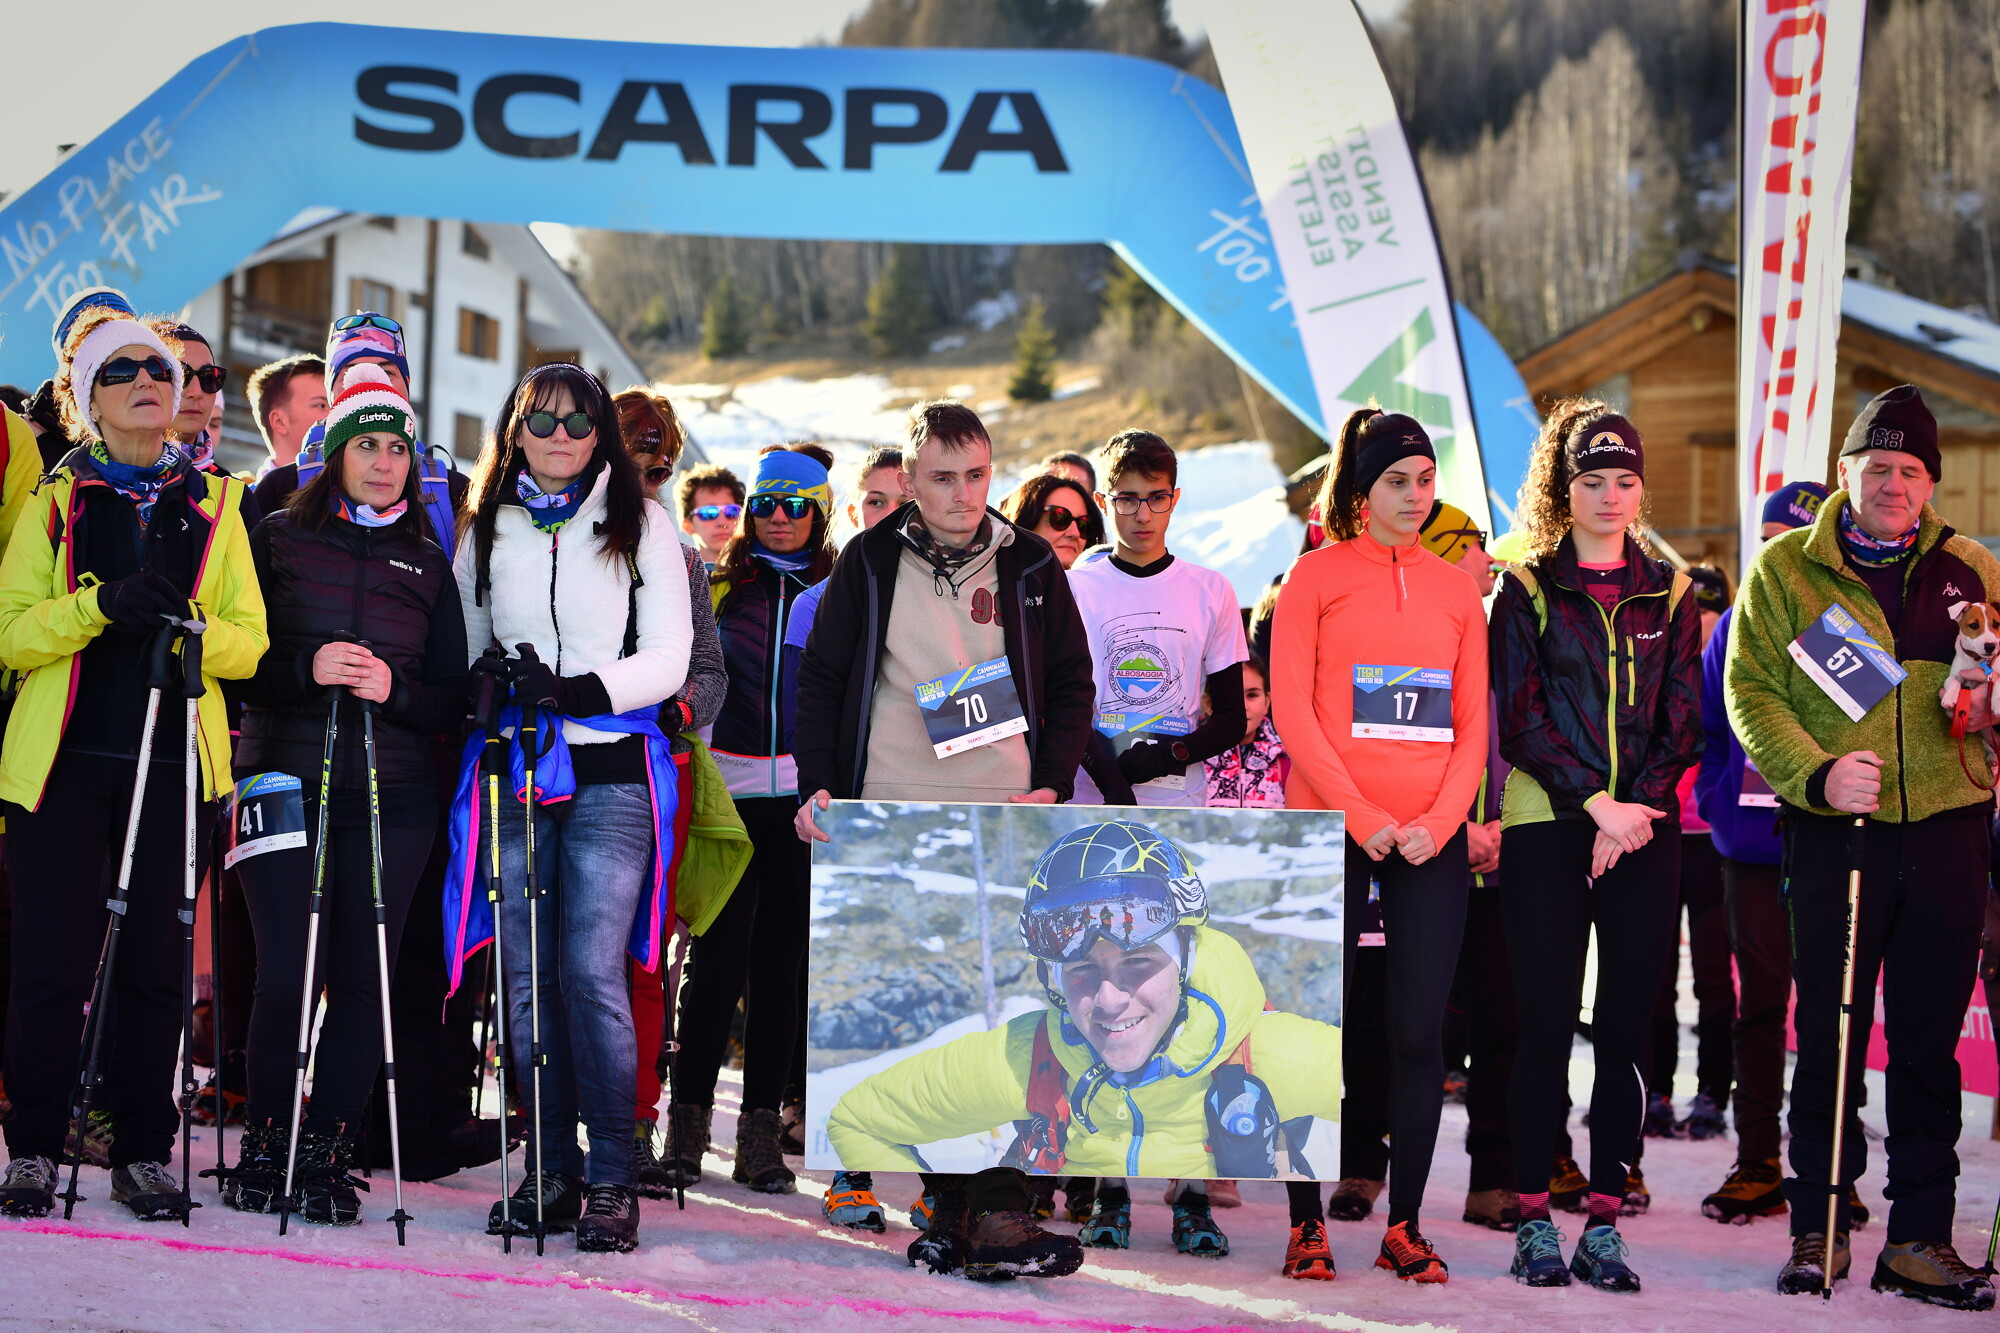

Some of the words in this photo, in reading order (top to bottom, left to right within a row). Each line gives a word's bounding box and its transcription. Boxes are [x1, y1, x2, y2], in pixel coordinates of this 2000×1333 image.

[353, 65, 1070, 173] SCARPA
[58, 115, 173, 233] PLACE
[358, 412, 394, 424] Eisbär
[1871, 427, 1905, 449] 68
[1577, 450, 1588, 459] LA
[1589, 445, 1637, 456] SPORTIVA
[1796, 489, 1821, 515] TE
[1637, 631, 1663, 639] CAMP
[1116, 670, 1164, 678] ALBOSAGGIA
[1826, 646, 1864, 679] 57
[955, 693, 988, 728] 70
[1393, 691, 1419, 721] 17
[240, 802, 264, 836] 41
[1085, 1062, 1107, 1081] CAM
